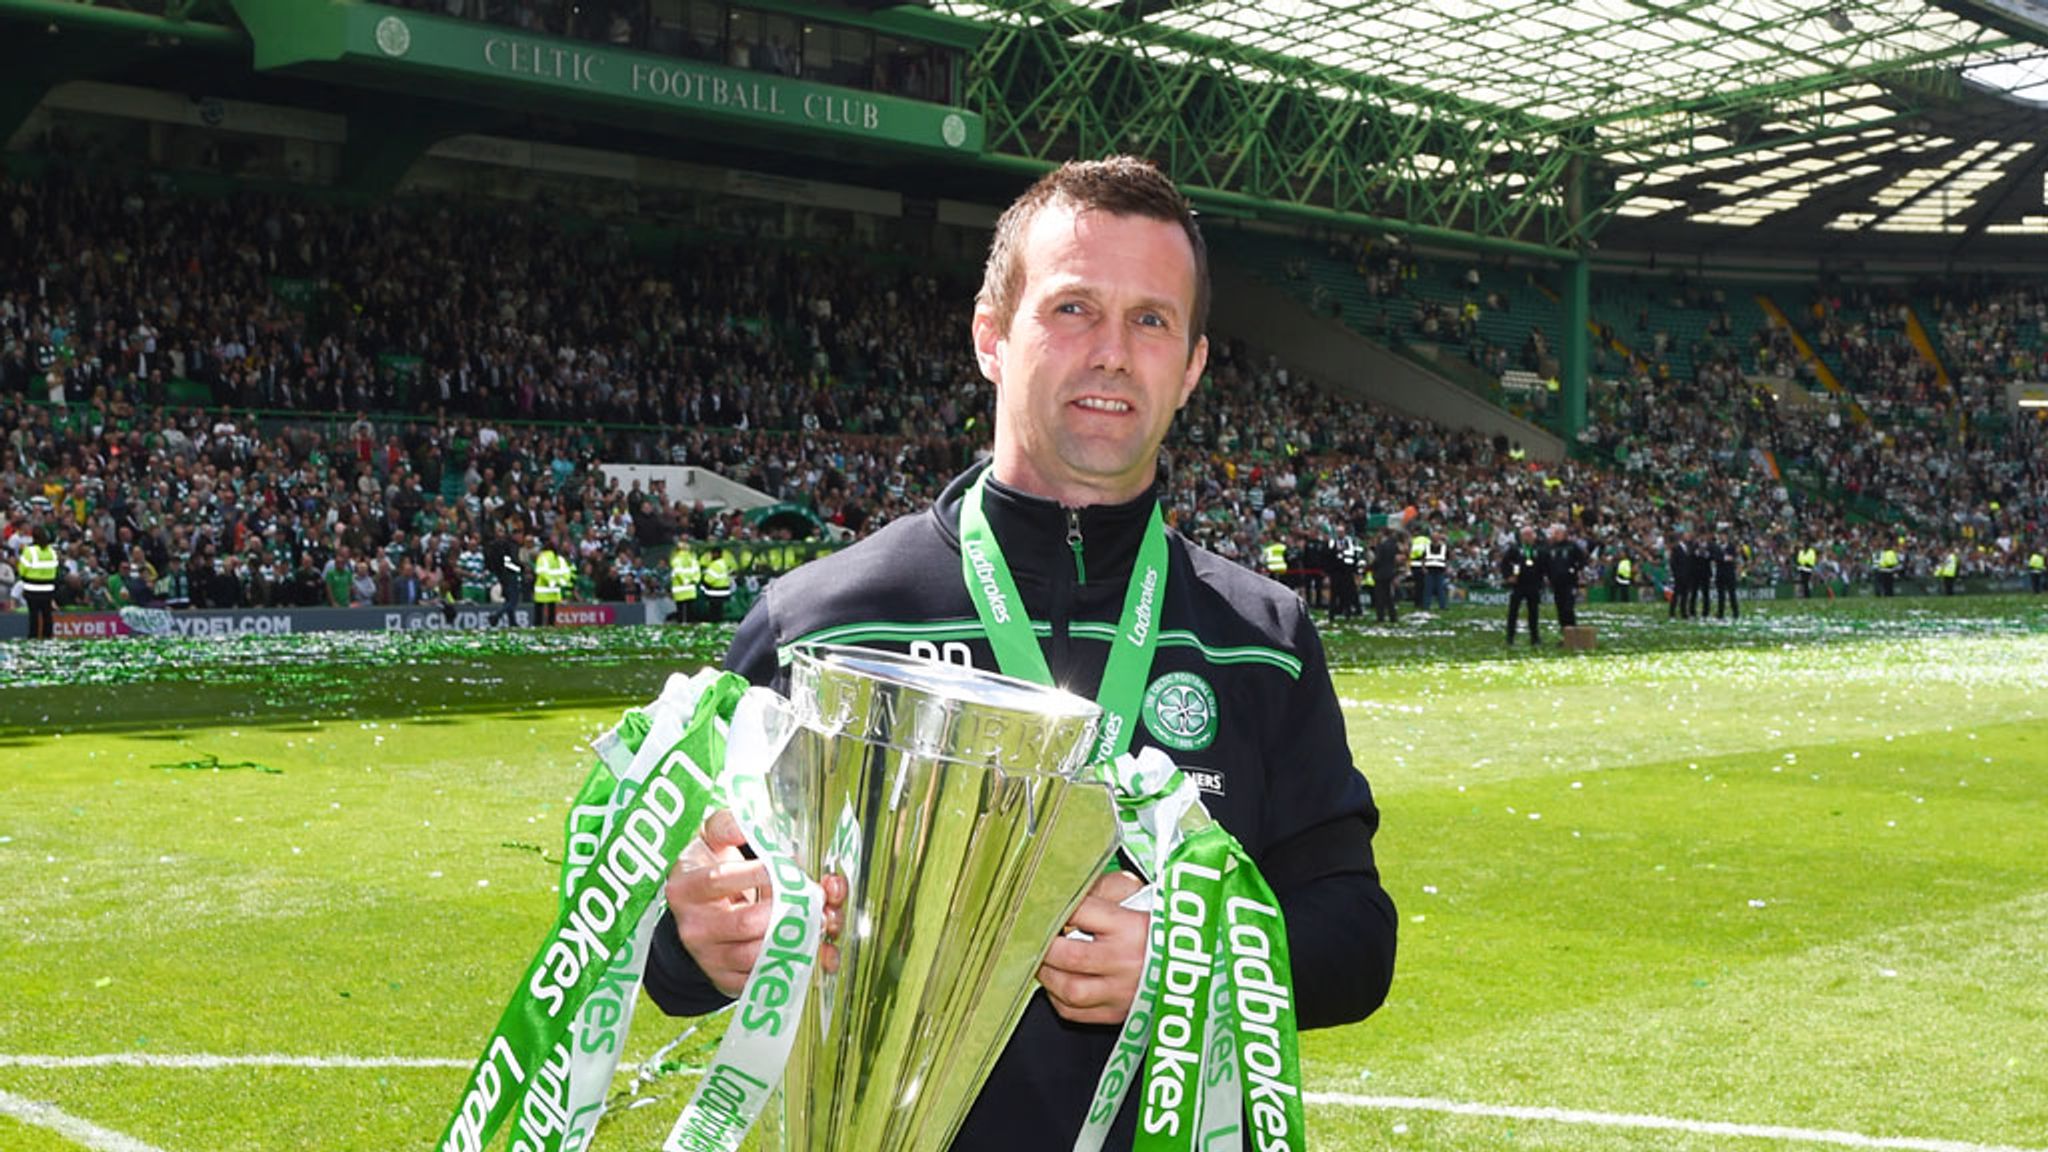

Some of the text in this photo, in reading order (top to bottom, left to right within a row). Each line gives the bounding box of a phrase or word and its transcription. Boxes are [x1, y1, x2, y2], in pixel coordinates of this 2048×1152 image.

[484, 38, 879, 130] CELTIC FOOTBALL CLUB
[556, 611, 597, 625] CLYDE
[966, 539, 1011, 624] Ladbrokes
[1127, 565, 1158, 648] Ladbrokes
[53, 621, 118, 636] CLYDE 1
[530, 751, 713, 1018] Ladbrokes
[1143, 861, 1221, 1137] Ladbrokes
[1226, 895, 1298, 1152] Ladbrokes
